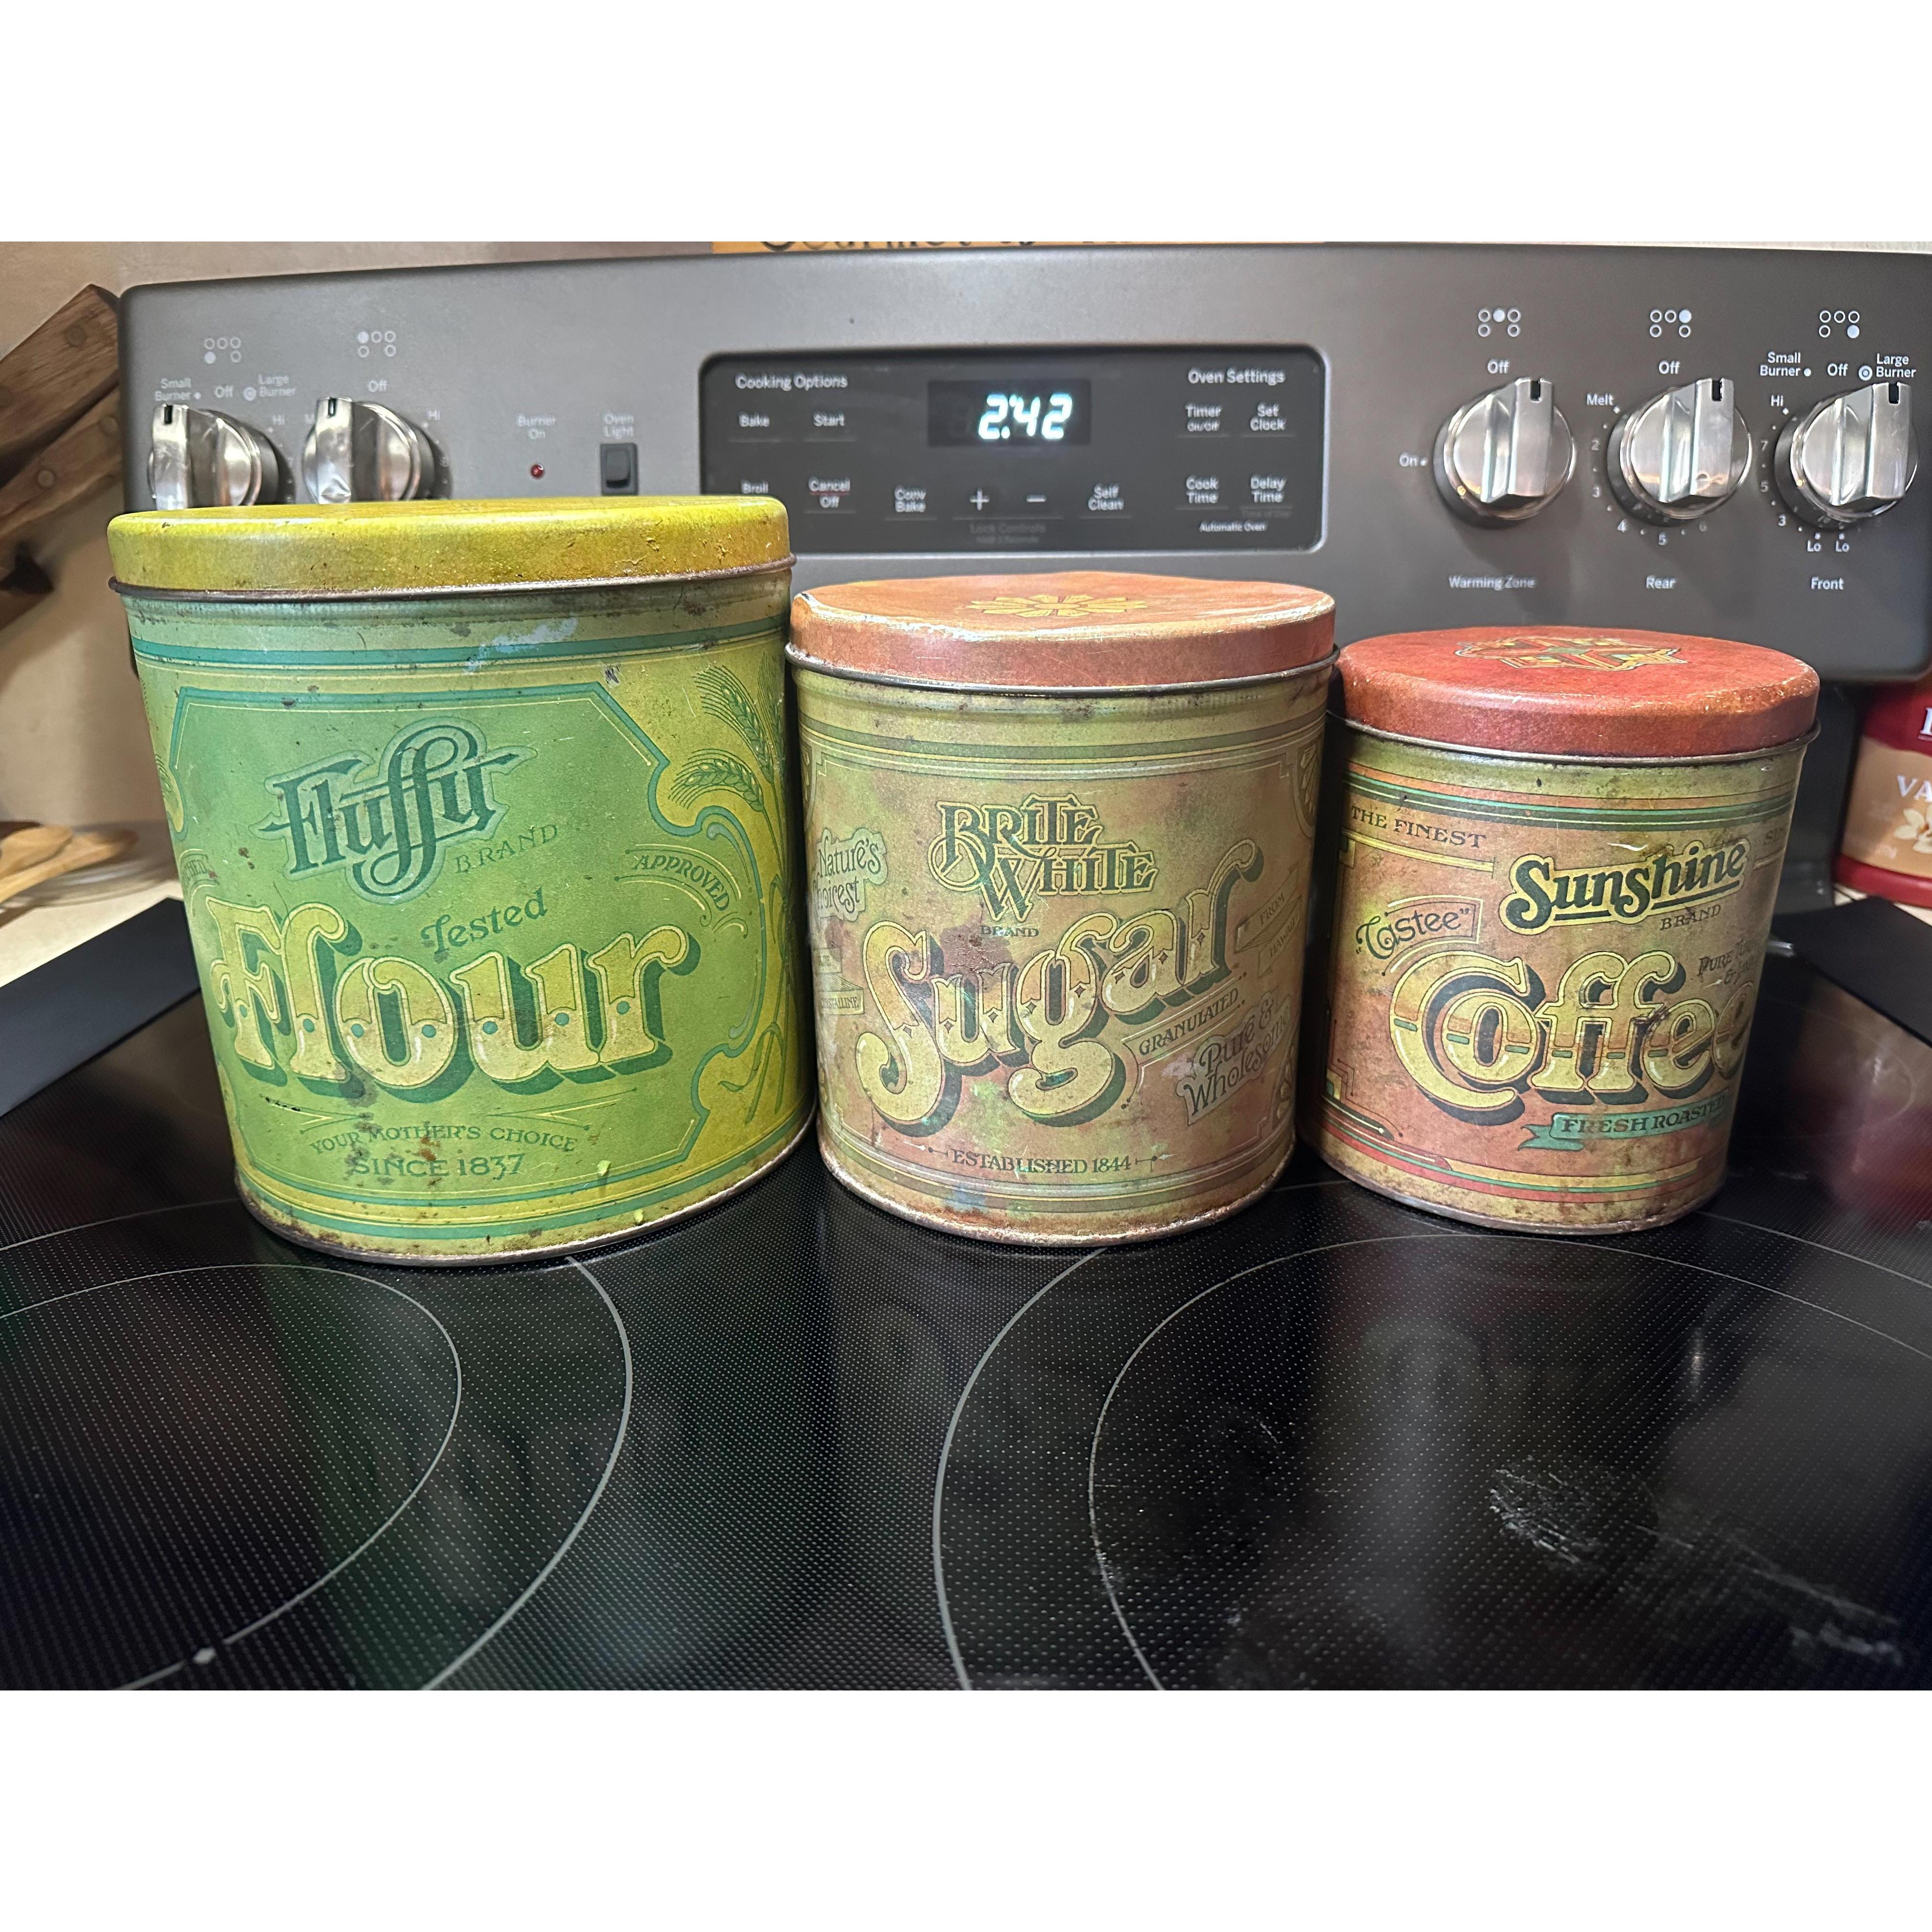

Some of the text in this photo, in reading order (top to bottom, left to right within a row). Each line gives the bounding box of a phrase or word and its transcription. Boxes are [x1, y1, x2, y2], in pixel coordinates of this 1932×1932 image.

[1767, 352, 1801, 364] Small
[1876, 353, 1909, 366] Large
[1487, 360, 1509, 374] Off
[1658, 360, 1680, 374] Off
[1760, 365, 1801, 376] Burner
[1827, 363, 1848, 376] Off
[1875, 365, 1916, 378] Burner
[161, 378, 191, 389] Small
[258, 374, 288, 386] Large
[735, 371, 848, 391] Cooking Options
[1188, 368, 1286, 385] Oven Settings
[214, 385, 234, 398] Off
[259, 386, 296, 397] Burner
[368, 380, 387, 392] Off
[155, 391, 191, 401] Burner
[1587, 393, 1614, 406] Melt
[1771, 395, 1783, 407] Hi
[978, 392, 1074, 440] 2:42
[1185, 402, 1222, 417] Timer
[1257, 402, 1279, 417] Set
[516, 414, 556, 426] Burner
[602, 413, 634, 425] Oven
[739, 413, 770, 427] Bake
[814, 412, 845, 427] Start
[1250, 416, 1287, 431] Clock
[528, 428, 546, 439] On
[603, 426, 633, 439] Light
[1591, 438, 1600, 451] 2
[1760, 440, 1769, 451] 7
[1399, 453, 1417, 467] On
[741, 480, 768, 494] Broil
[808, 477, 851, 492] Cancel
[1185, 475, 1219, 490] Cook
[1250, 474, 1286, 491] Delay
[1760, 479, 1769, 493] 5
[894, 486, 926, 500] Conv
[1093, 484, 1119, 499] Self
[1187, 490, 1219, 504] Time
[1253, 489, 1284, 503] Time
[1592, 484, 1602, 498] 3
[820, 496, 840, 509] Off
[895, 499, 926, 513] Bake
[1088, 498, 1124, 511] Clean
[1199, 519, 1267, 532] Automatic Oven
[1617, 518, 1630, 533] 4
[1778, 514, 1786, 526] 3
[1658, 531, 1669, 546] 5
[1807, 540, 1821, 552] Lo
[1835, 540, 1850, 552] Lo
[1449, 575, 1536, 591] Warming Zone
[1645, 576, 1676, 590] Rear
[1811, 577, 1844, 590] Front
[1351, 805, 1486, 848] THE FINEST
[929, 793, 1104, 886] BRITE
[455, 823, 559, 874] BRAND
[818, 835, 881, 875] Nature's
[631, 854, 730, 911] APPROVED
[982, 841, 1160, 922] WHITE
[1505, 842, 1747, 930] Sunshine
[1259, 893, 1285, 925] FROM
[421, 886, 548, 954] Tested
[1660, 905, 1721, 931] BRAND
[981, 925, 1039, 937] BRAND
[856, 839, 1260, 1129] Sugar
[205, 896, 694, 1093] Flour
[1138, 988, 1239, 1056] GRANULATED
[1199, 997, 1275, 1076] Pure &
[1389, 950, 1755, 1113] Coffee
[1184, 1005, 1289, 1115] Wholesome
[1562, 1117, 1650, 1132] FRESH
[310, 1121, 578, 1155] YOUR MOTHER'S CHOICE
[354, 1153, 526, 1180] SINCE 1837
[952, 1150, 1131, 1173] ESTABLISHED 1844
